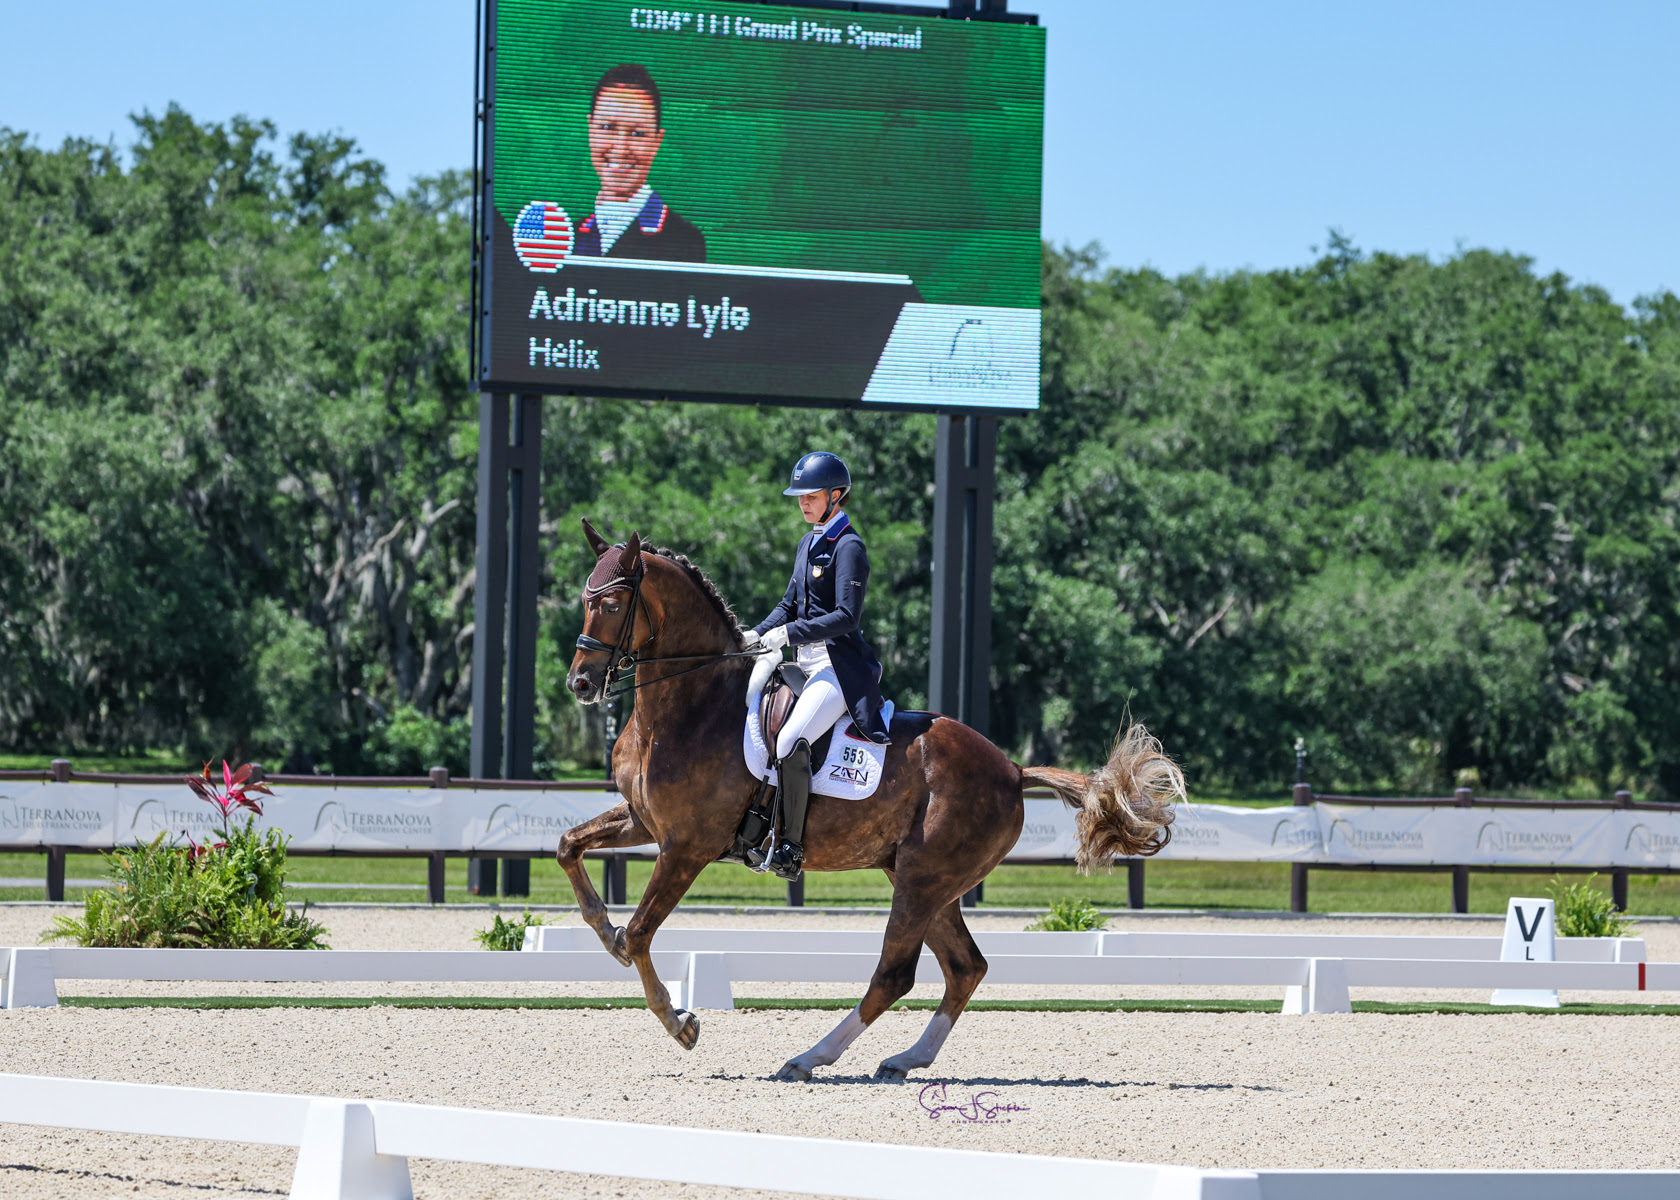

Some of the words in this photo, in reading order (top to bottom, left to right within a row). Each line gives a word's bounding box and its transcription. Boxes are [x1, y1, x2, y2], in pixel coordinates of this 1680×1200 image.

[734, 16, 798, 40] Grand
[801, 21, 842, 42] Prix
[846, 23, 922, 50] Special
[528, 286, 681, 327] Adrienne
[687, 295, 750, 338] Lyle
[529, 336, 600, 369] Helix
[843, 746, 864, 765] 553
[1514, 906, 1546, 942] V
[1526, 946, 1535, 961] L
